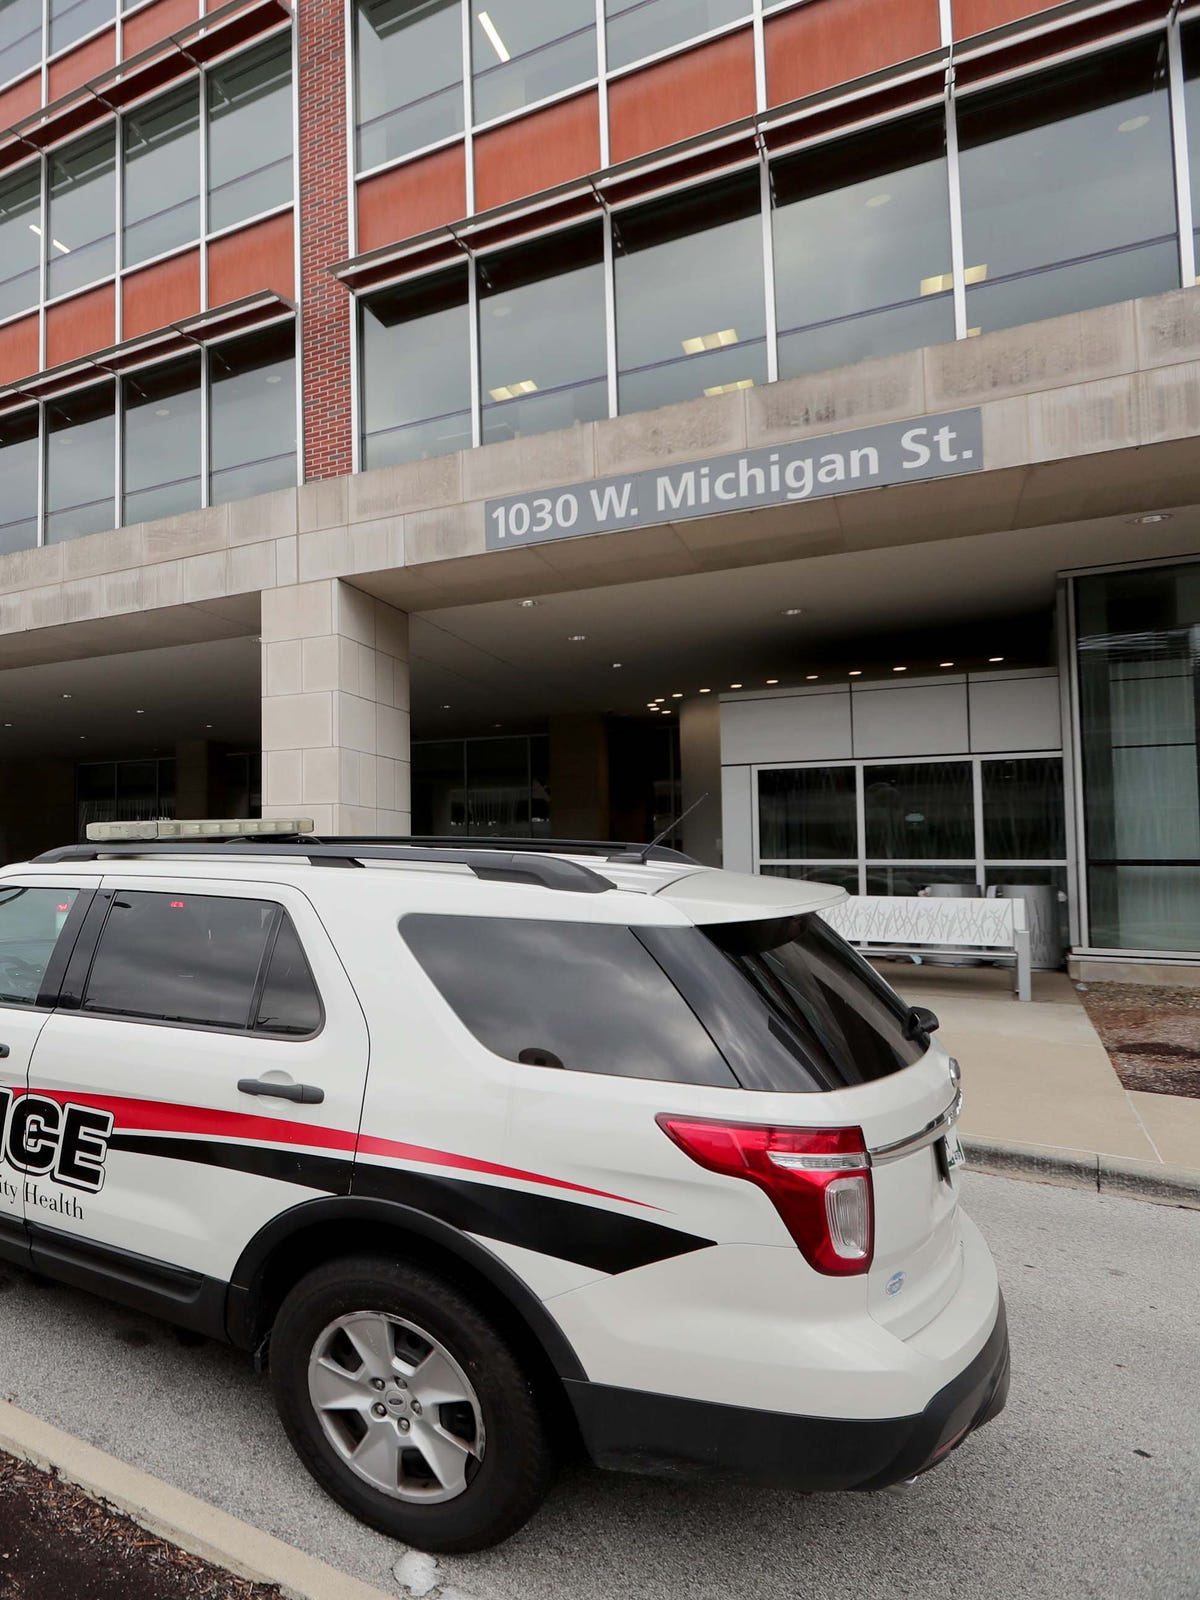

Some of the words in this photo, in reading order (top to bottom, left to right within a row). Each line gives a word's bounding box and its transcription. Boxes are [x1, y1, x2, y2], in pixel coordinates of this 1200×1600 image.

[490, 493, 579, 539] 1030
[590, 482, 639, 522] W.
[655, 446, 879, 514] Michigan
[900, 424, 974, 469] St.
[24, 1181, 84, 1220] Health
